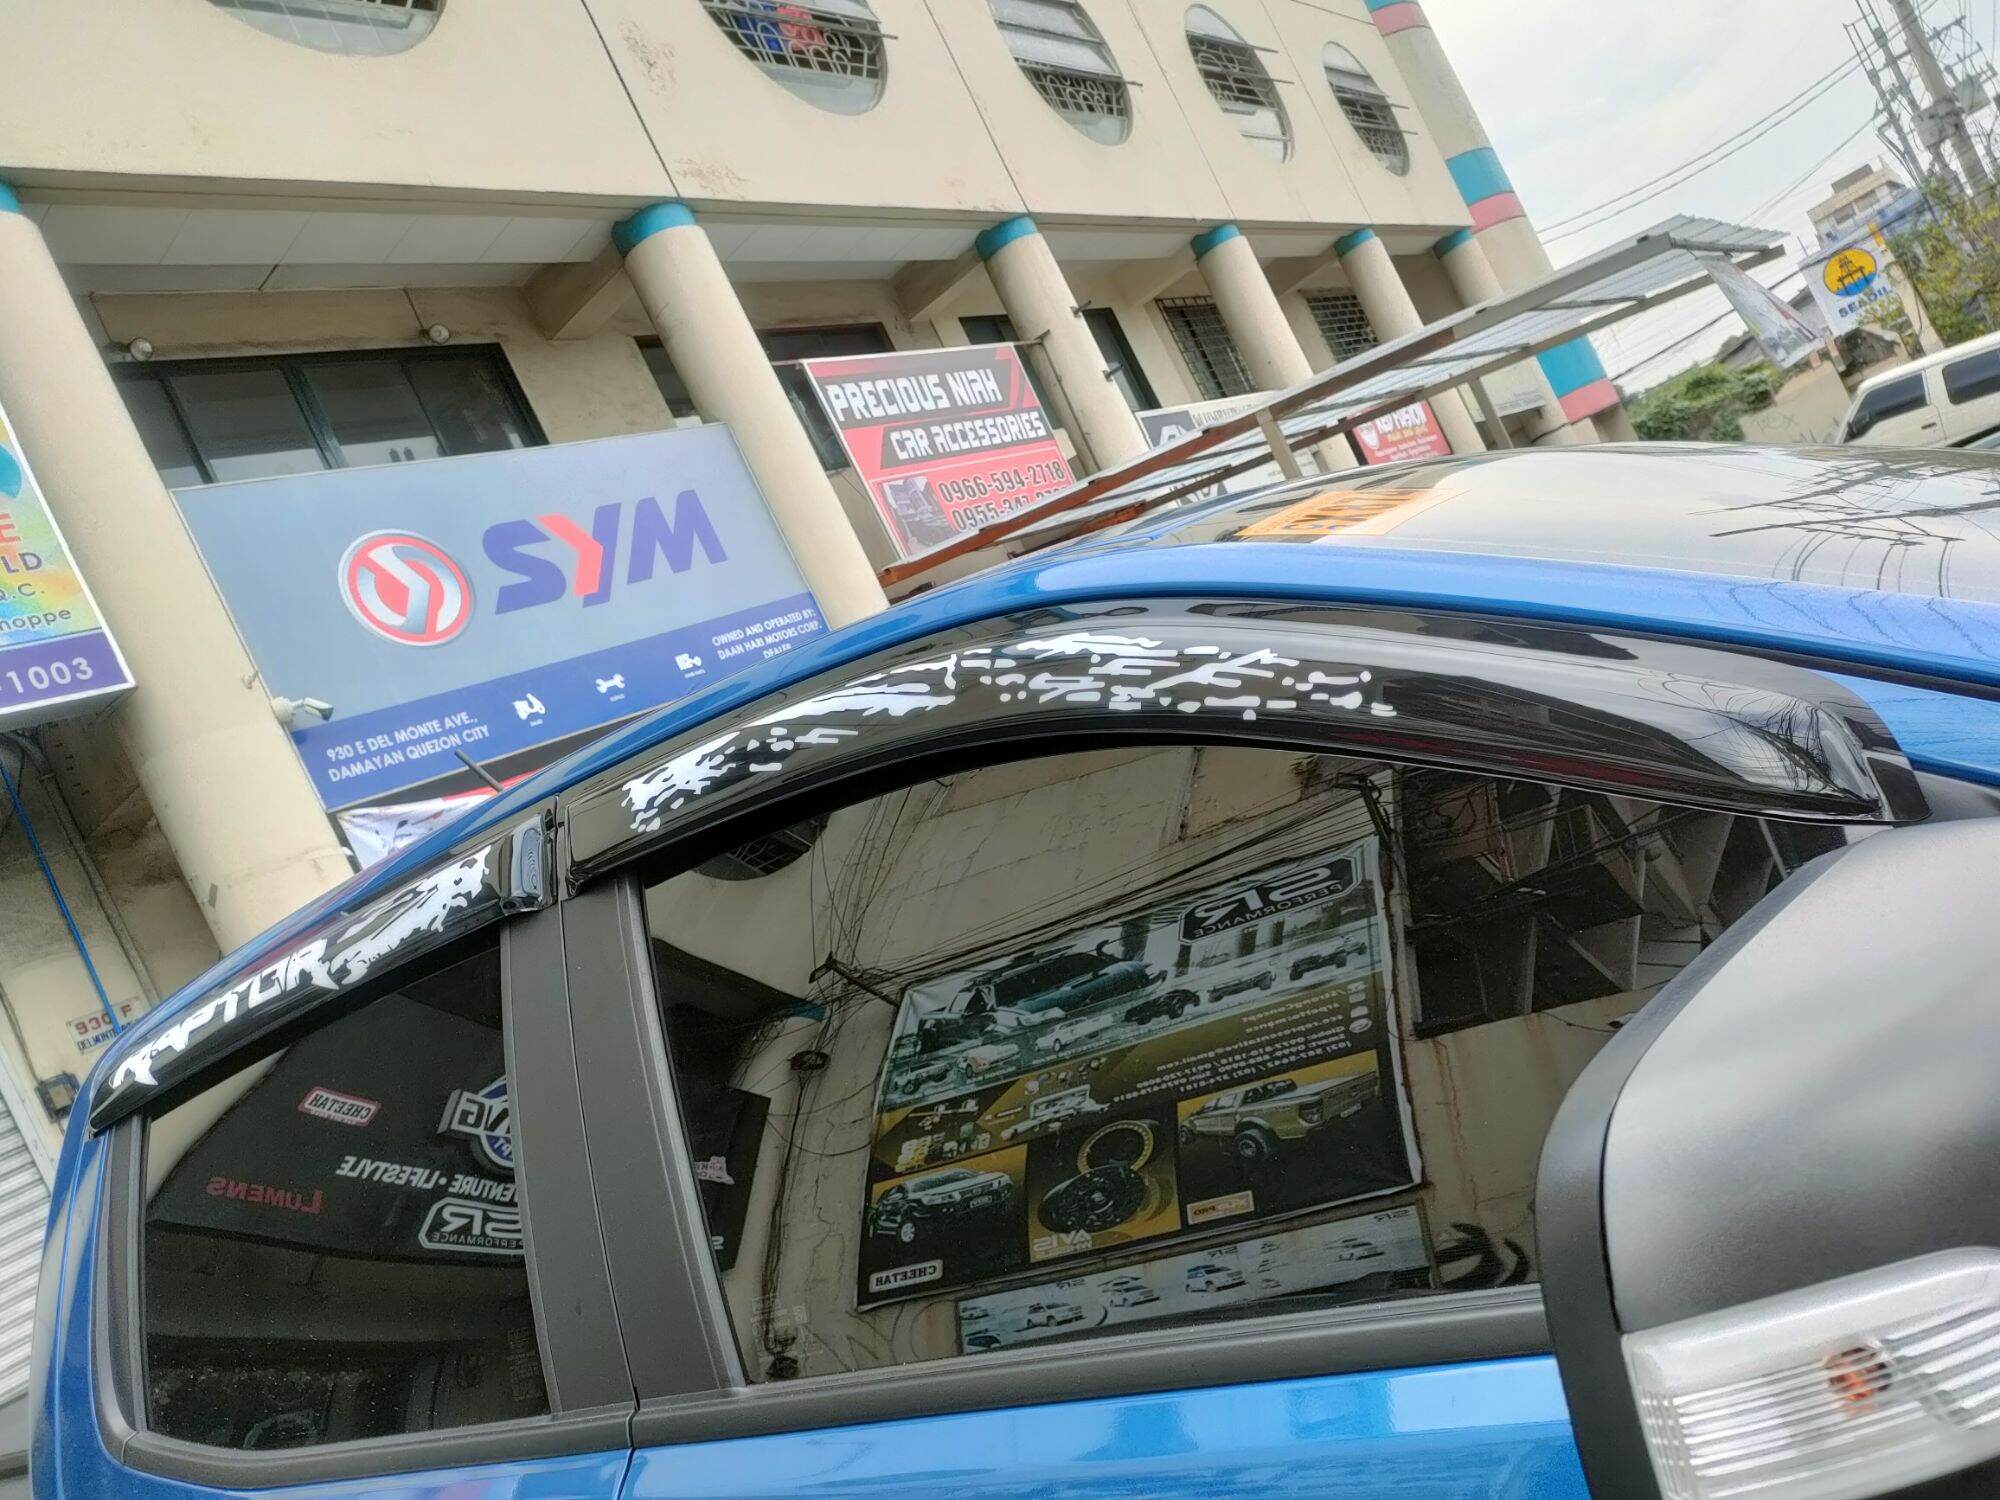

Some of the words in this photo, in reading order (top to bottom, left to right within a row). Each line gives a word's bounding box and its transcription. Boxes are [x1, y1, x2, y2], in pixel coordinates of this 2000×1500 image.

[825, 373, 951, 421] PRECIOUS
[946, 369, 1003, 407] NIAH
[890, 429, 933, 461] CAR
[932, 411, 1048, 453] ACCESSORIES
[938, 461, 1066, 503] 0966-594-2718
[481, 489, 728, 615] SYM
[712, 629, 745, 647] OWNED
[745, 623, 764, 637] AND
[764, 610, 802, 631] OPERATED
[717, 644, 745, 660] DAAN
[765, 627, 798, 645] MOTORS
[798, 620, 823, 634] CORP.
[326, 745, 354, 762] 930
[357, 741, 367, 755] E
[366, 734, 393, 752] DEL
[395, 720, 442, 745] MONTE
[328, 751, 405, 783] DAMAYAN
[406, 734, 463, 760] QUEZON
[462, 725, 490, 744] CITY
[92, 1029, 118, 1045] MONT
